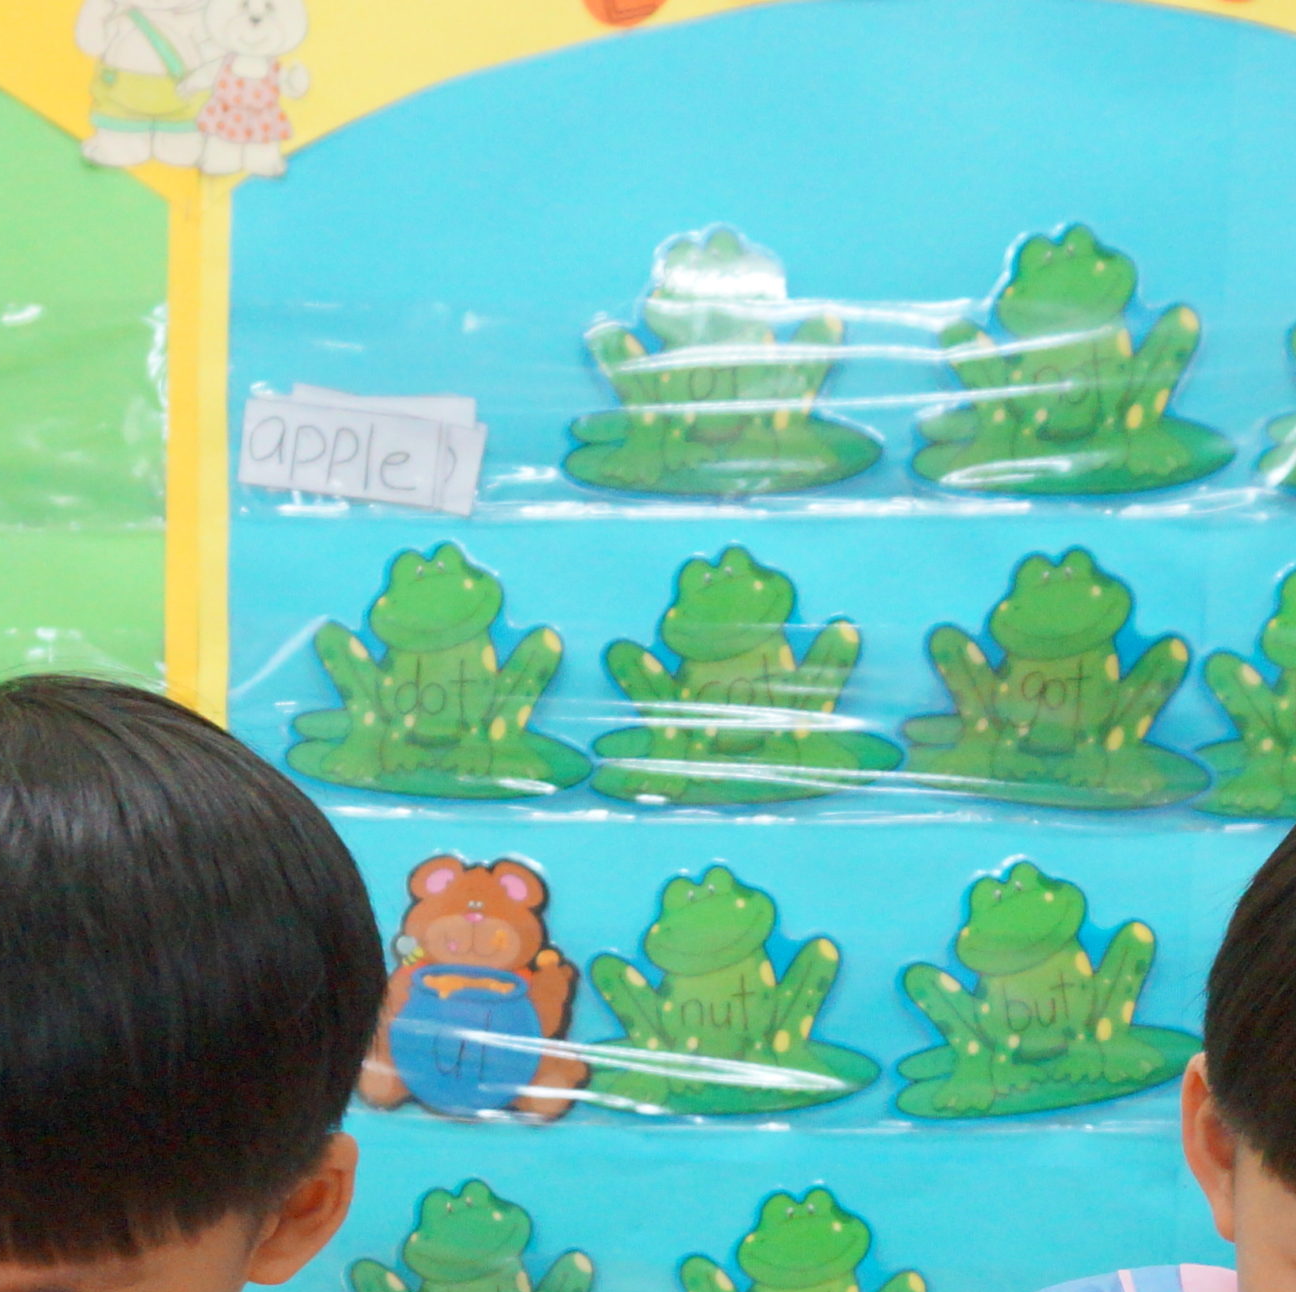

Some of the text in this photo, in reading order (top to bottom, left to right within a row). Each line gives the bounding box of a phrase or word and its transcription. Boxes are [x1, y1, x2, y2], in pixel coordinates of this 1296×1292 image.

[249, 414, 417, 492] apple
[394, 656, 478, 729] dot
[1013, 659, 1092, 729] got
[680, 973, 756, 1032] nut
[1001, 968, 1076, 1033] but
